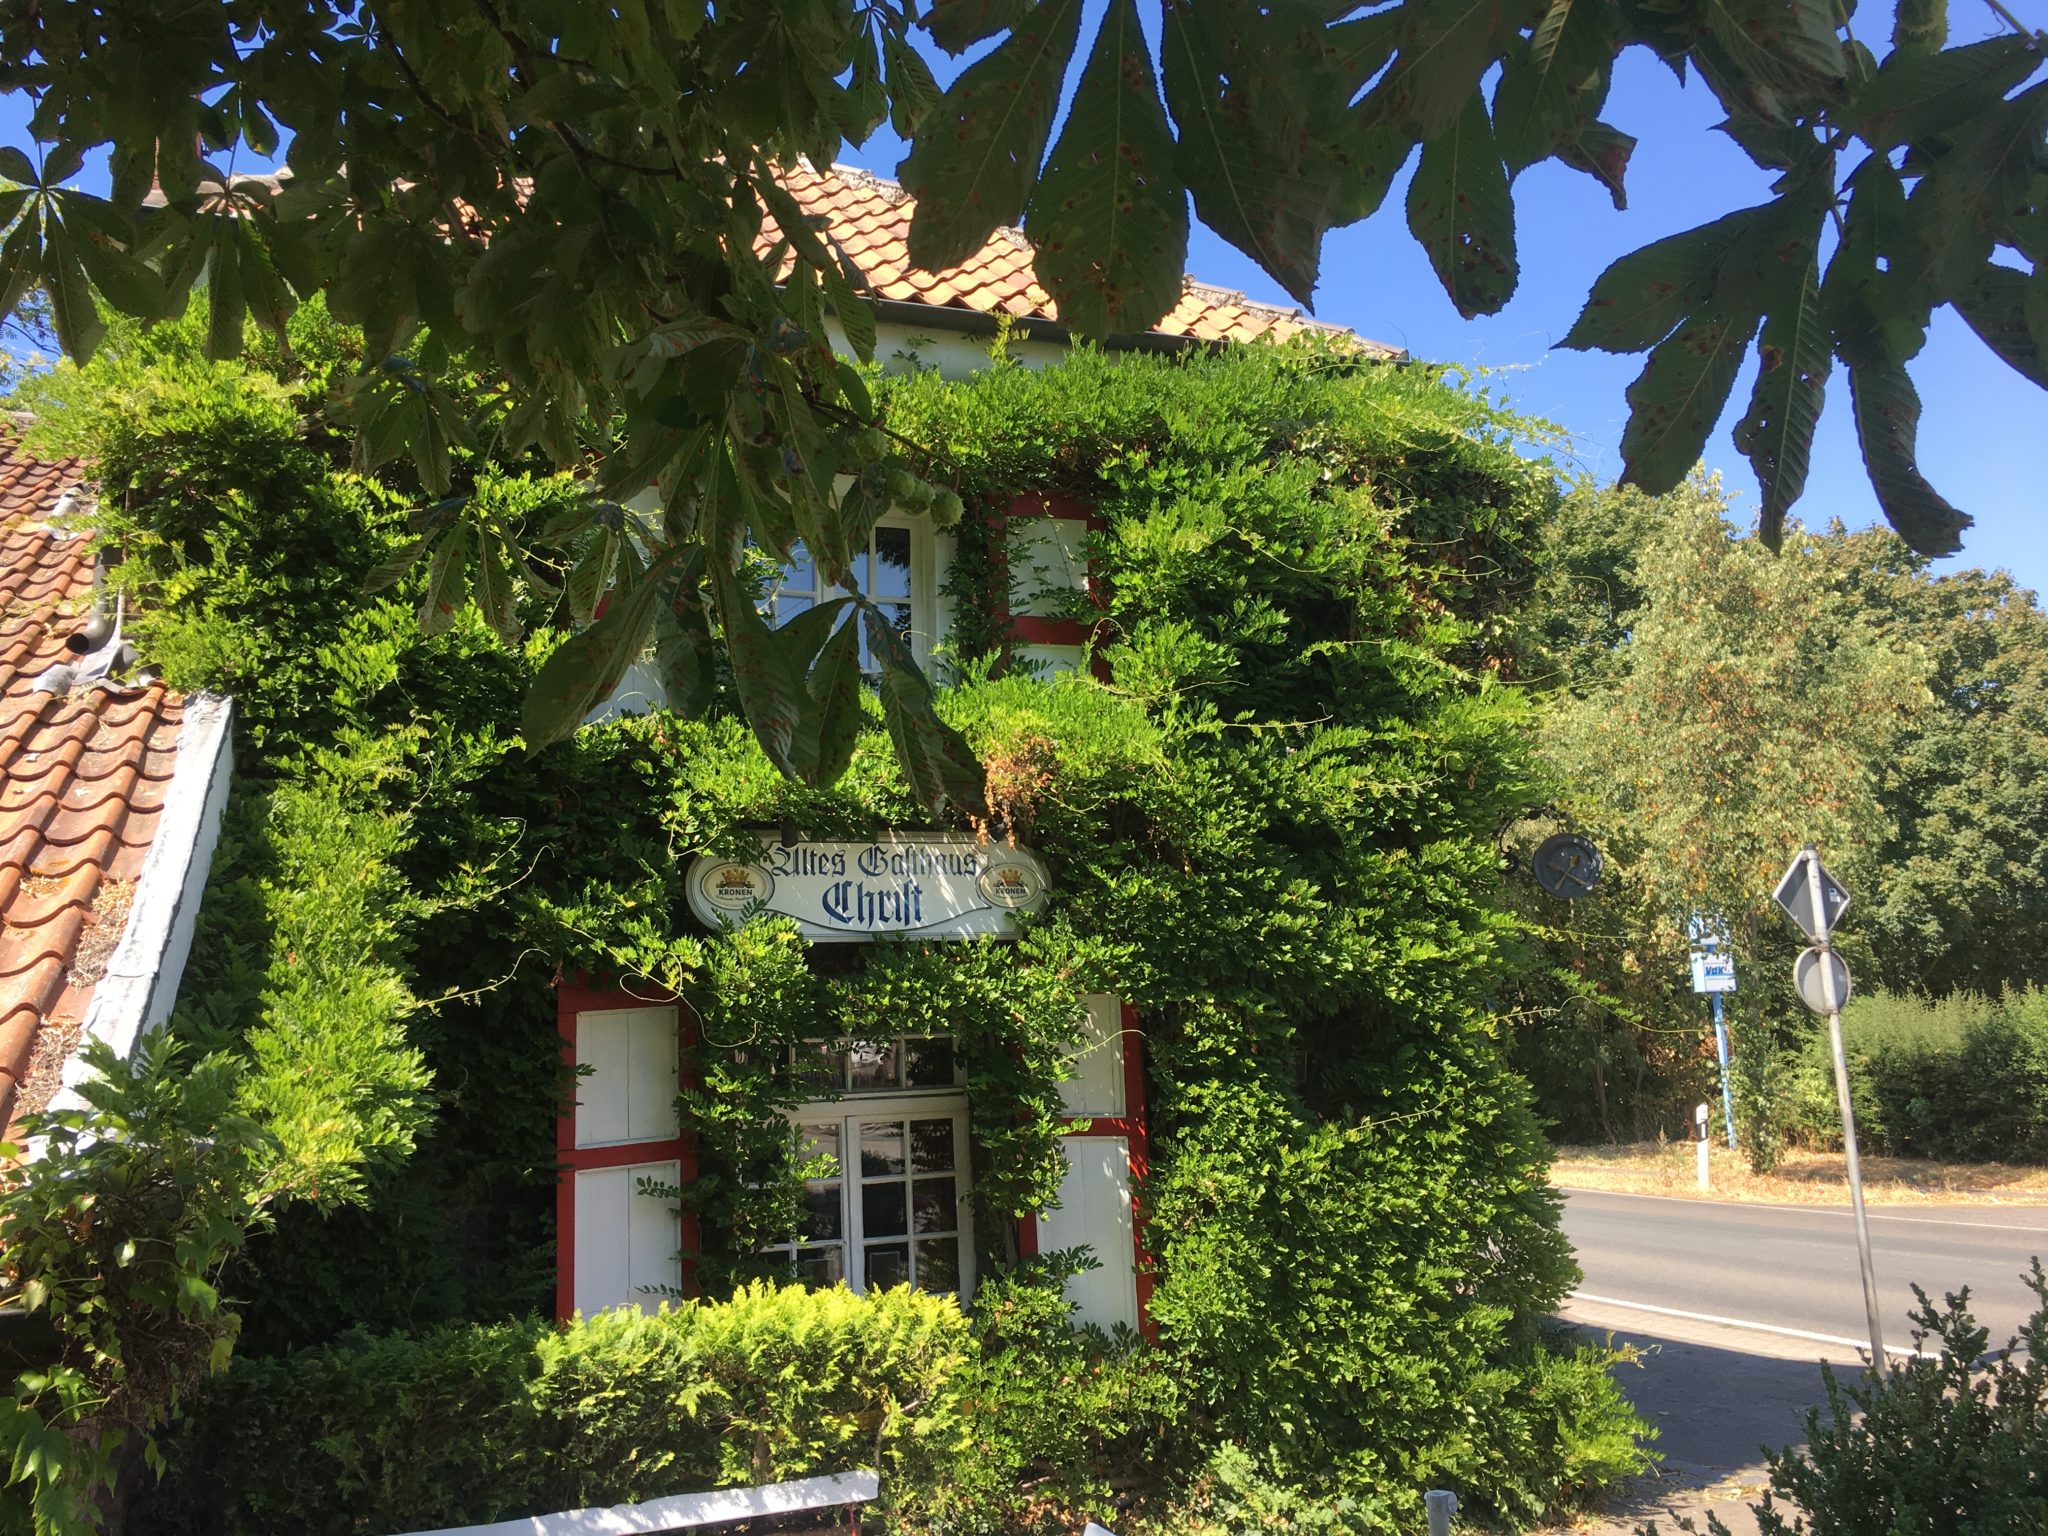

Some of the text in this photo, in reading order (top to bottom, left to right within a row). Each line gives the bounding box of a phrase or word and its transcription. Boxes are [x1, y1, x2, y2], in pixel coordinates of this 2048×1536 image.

[771, 846, 846, 877] Altes
[718, 888, 753, 896] KRONEN
[995, 887, 1026, 895] KRONEN
